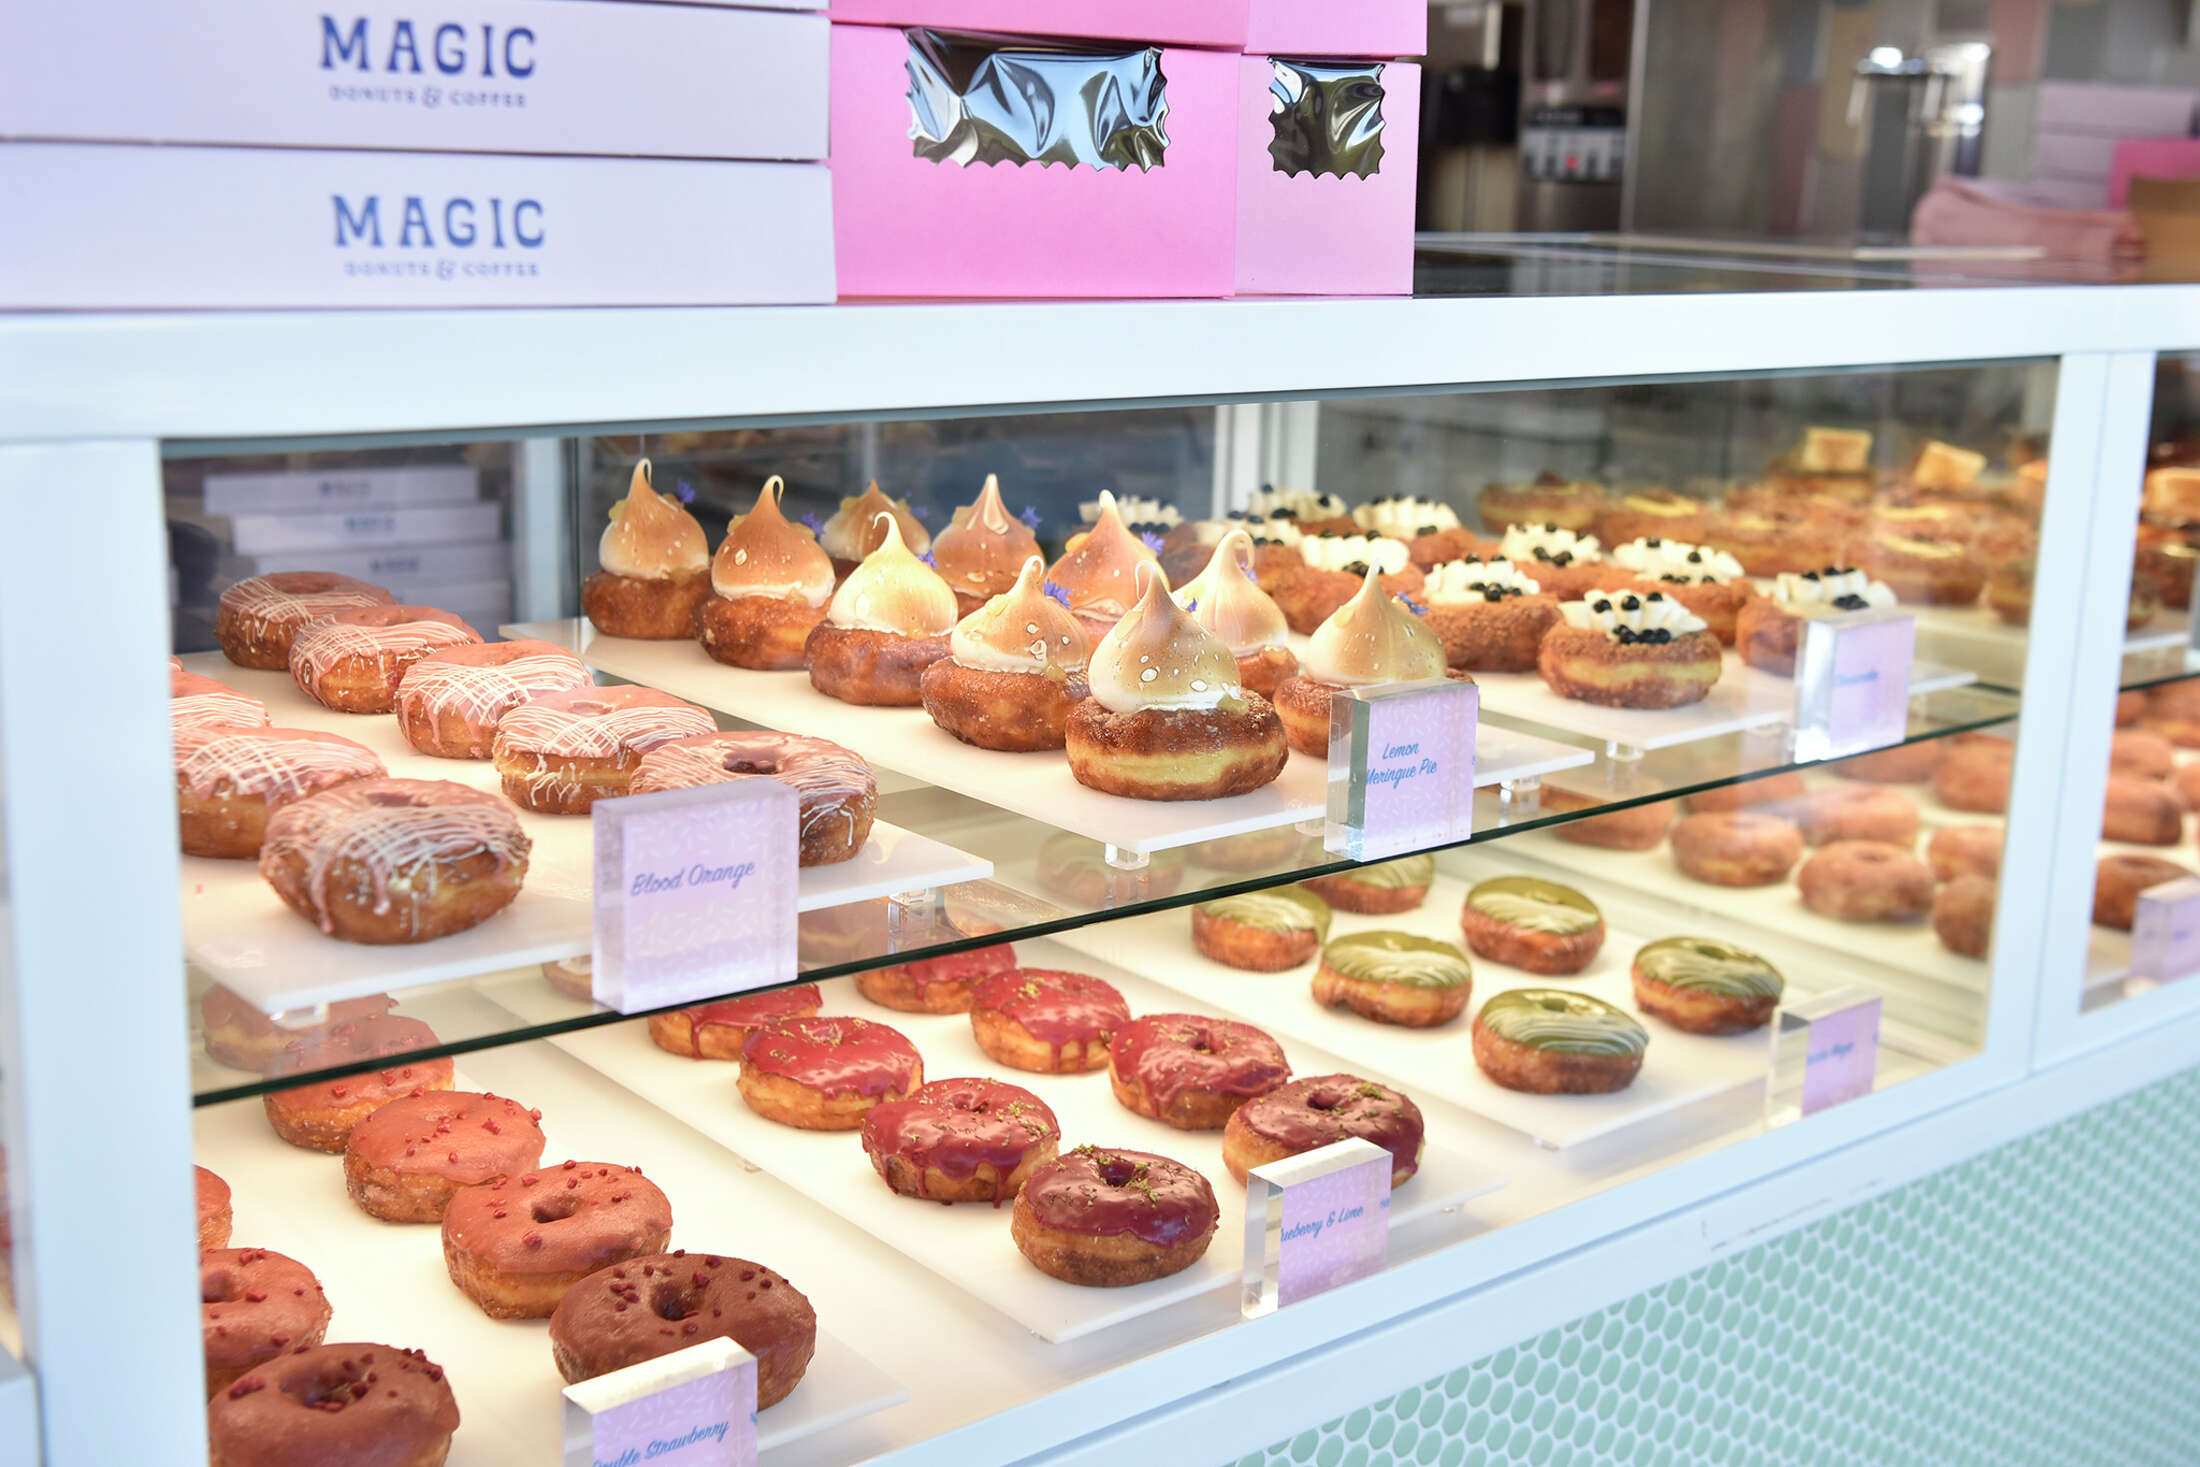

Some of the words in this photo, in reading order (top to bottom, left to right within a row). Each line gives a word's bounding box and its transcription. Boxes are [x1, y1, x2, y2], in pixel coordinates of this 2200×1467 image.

[320, 13, 536, 79] MAGIC
[329, 84, 417, 104] DONUTS
[422, 86, 441, 108] &
[449, 90, 527, 108] COFFEE
[331, 193, 546, 249] MAGIC
[344, 259, 430, 276] DONUTS
[1382, 743, 1420, 760] Lemon
[1419, 757, 1438, 776] Pie
[631, 867, 686, 896] Blood
[688, 861, 755, 889] Orange
[1280, 1219, 1323, 1241] lueberry
[645, 1420, 729, 1460] Strawberry
